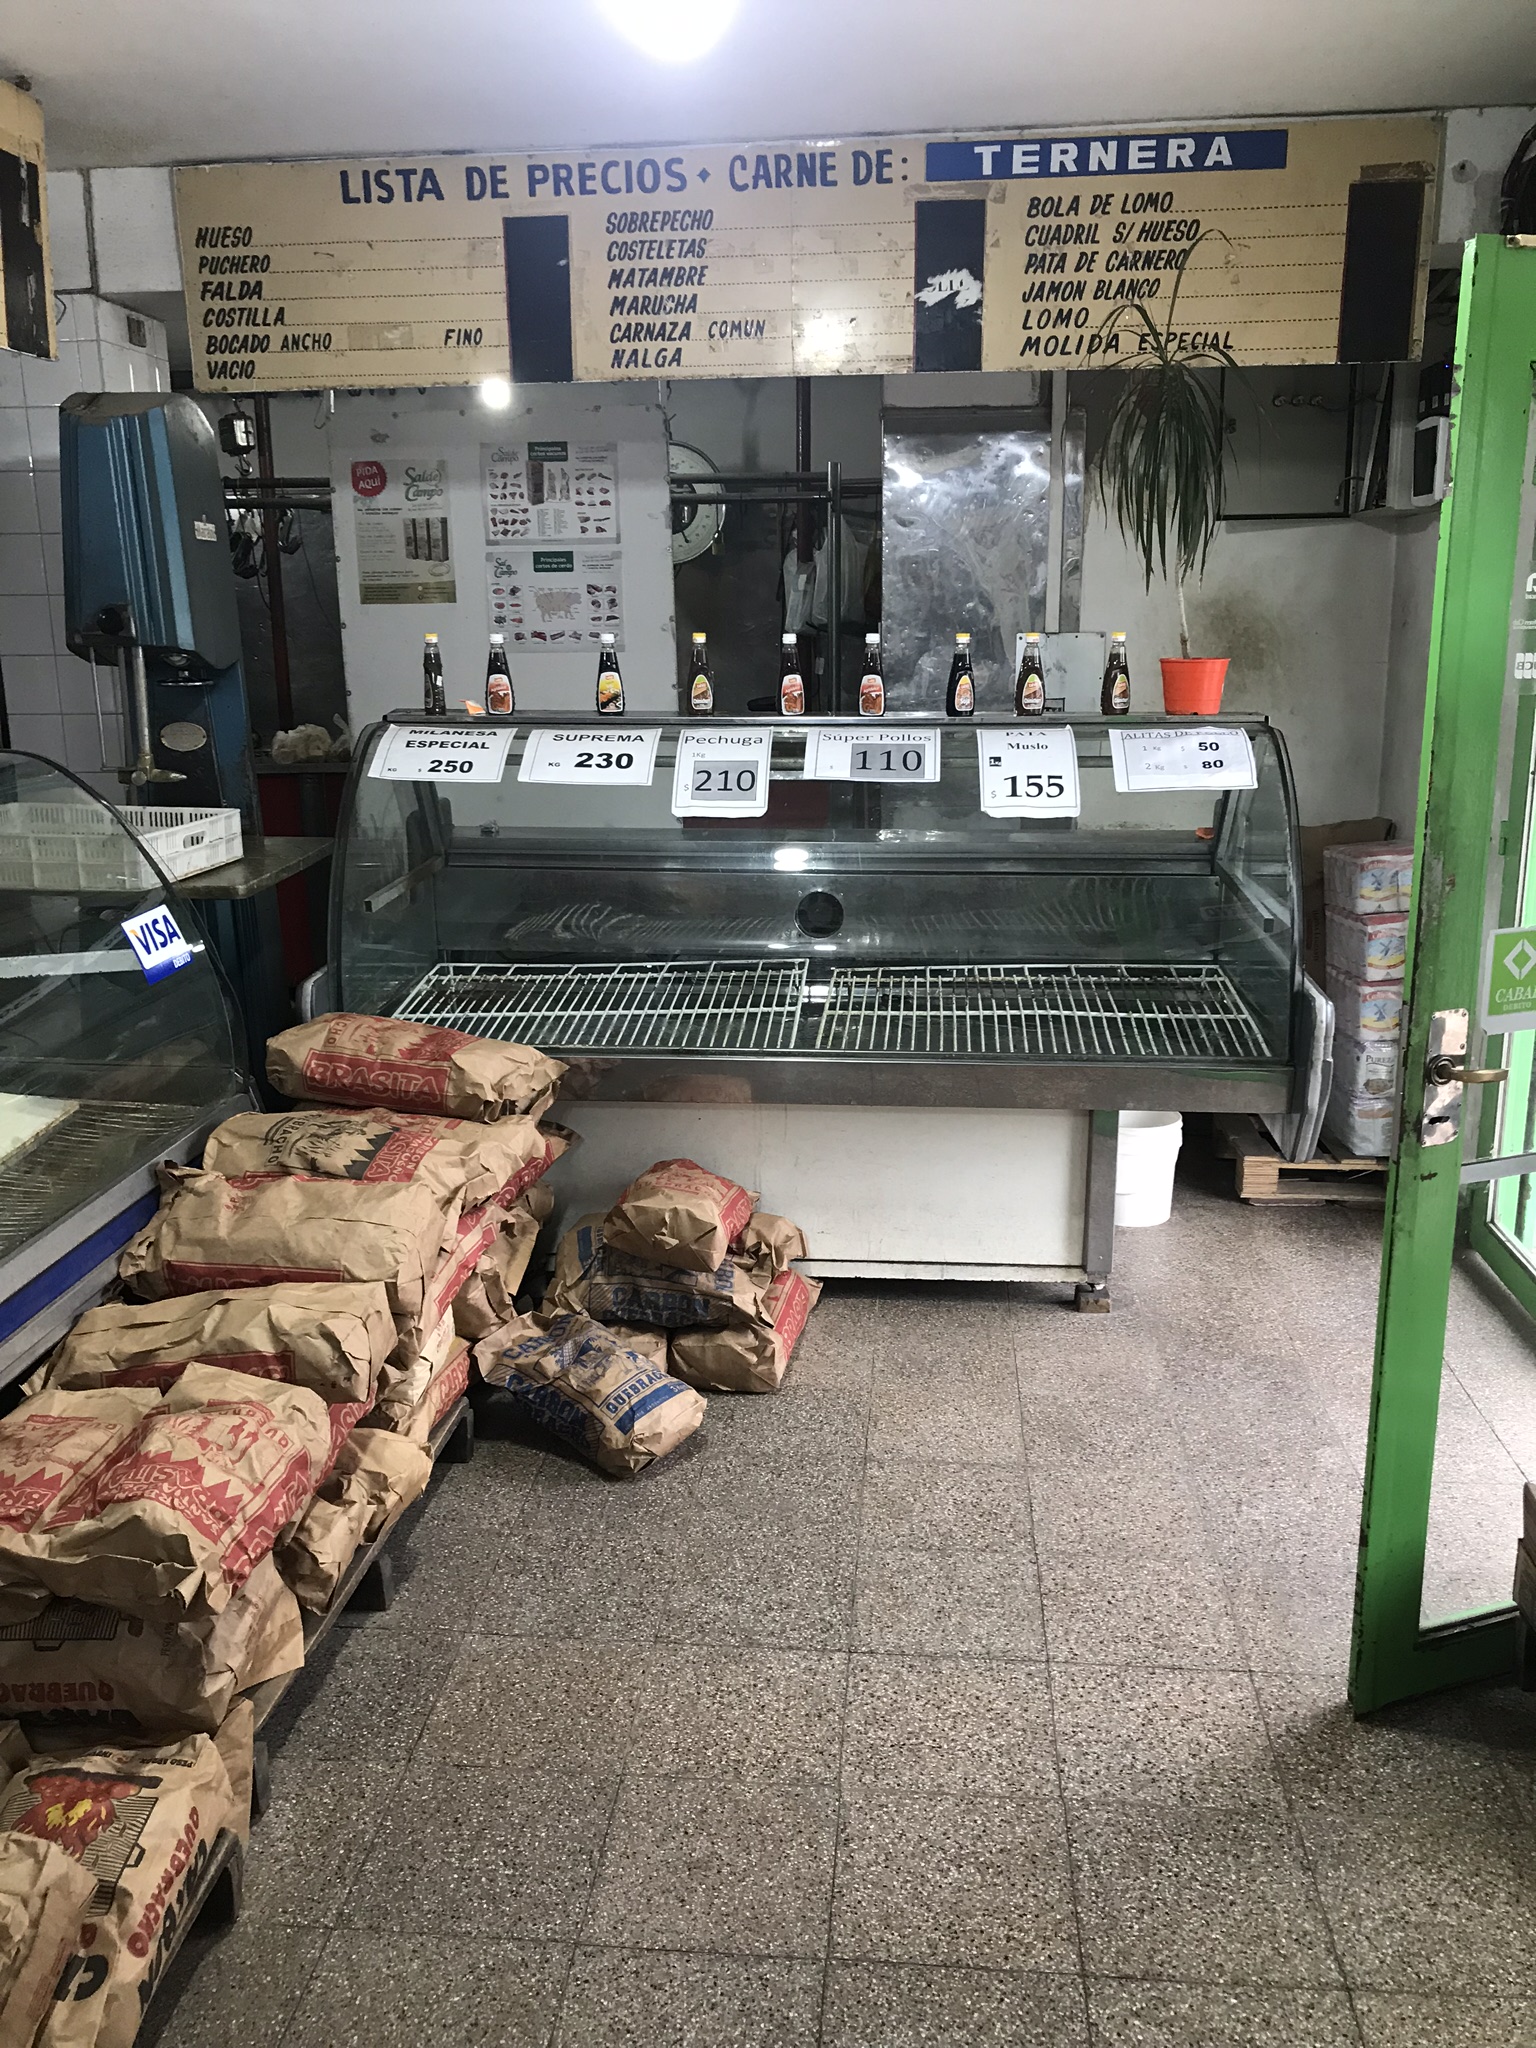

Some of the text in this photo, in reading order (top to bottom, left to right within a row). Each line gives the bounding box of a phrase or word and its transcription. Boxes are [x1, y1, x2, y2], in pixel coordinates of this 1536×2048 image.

[974, 136, 1233, 176] TERNERA
[339, 168, 445, 204] LISTA
[466, 165, 510, 200] DE
[527, 157, 688, 197] PRECIOS
[729, 150, 838, 192] CARNE
[1027, 191, 1173, 218] BOLA DE LOMO
[606, 209, 713, 235] SOBREPECHO
[1025, 223, 1100, 247] CUADRIL
[1137, 219, 1200, 242] HUESO
[195, 226, 252, 248] HUESO
[607, 238, 706, 262] COSTELETAS
[1024, 248, 1189, 275] PATA DE CARNERO
[199, 254, 270, 275] PUCHERO
[607, 266, 708, 289] MATAMBRE
[200, 280, 263, 301] FALDA
[1021, 278, 1161, 303] JAMON BLANCO
[609, 293, 697, 317] MARUCHA
[203, 307, 285, 327] COSTILLA
[1021, 307, 1090, 330] LOMO
[207, 327, 483, 354] BOCADO ANCHO FINO
[610, 319, 765, 343] CARNAZA COMUN
[1019, 330, 1234, 357] MOLIDA ESPECIAL
[611, 347, 682, 369] NALGA
[207, 360, 255, 380] VACIO
[356, 466, 379, 477] PIDA
[404, 483, 443, 502] Campo
[409, 729, 498, 737] MILANESA
[552, 733, 645, 743] SUPREMA
[684, 735, 764, 746] Pechuga
[879, 733, 932, 742] Pollos
[1124, 731, 1171, 740] ALITAS
[405, 740, 490, 750] ESPECIAL
[1198, 742, 1220, 752] 50
[427, 760, 474, 774] 250
[574, 752, 634, 769] 230
[855, 750, 922, 772] 110
[1202, 759, 1224, 769] 80
[683, 769, 756, 792] $ 210
[991, 775, 1064, 799] $ 155
[129, 914, 181, 955] VISA
[1366, 1054, 1395, 1063] PUREZ
[307, 1060, 441, 1102] BRASITA
[606, 1369, 668, 1414] QUEBRAC
[0, 1680, 114, 1703] QUEBRAC
[127, 1806, 200, 1957] QUEBRACHO
